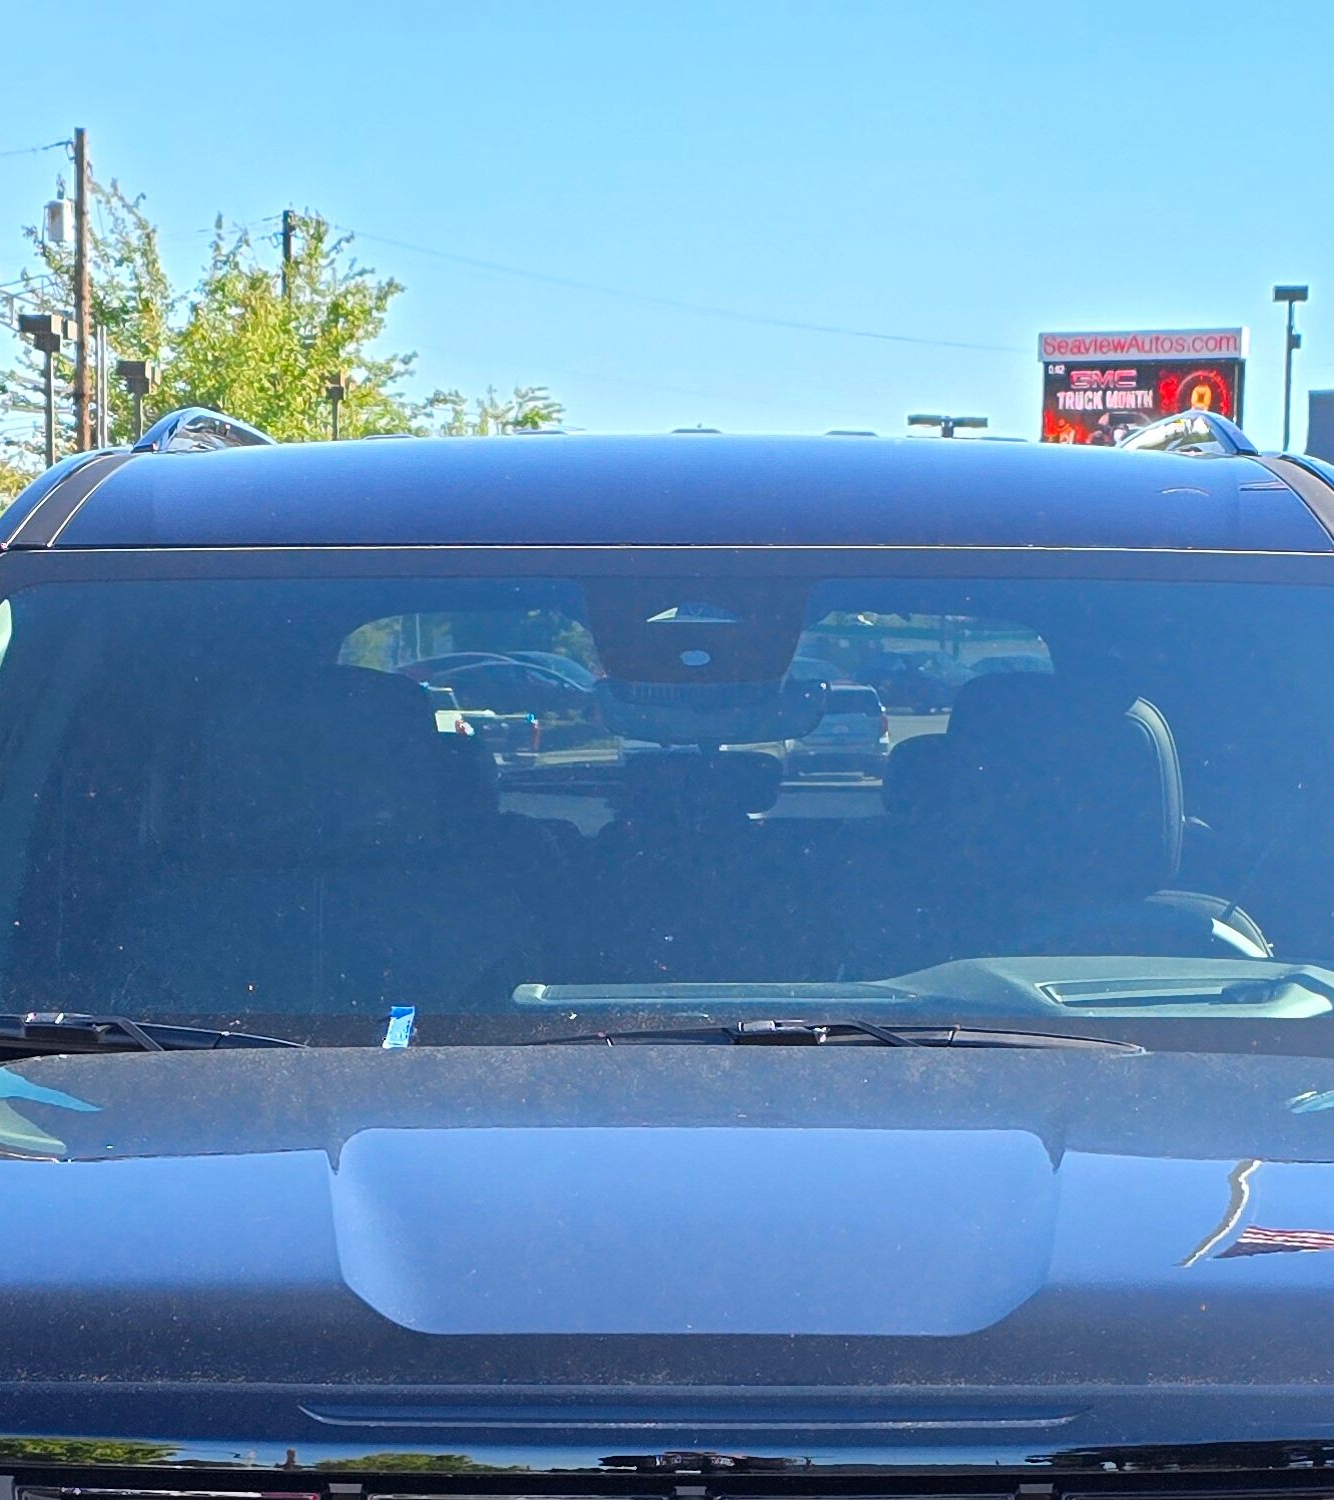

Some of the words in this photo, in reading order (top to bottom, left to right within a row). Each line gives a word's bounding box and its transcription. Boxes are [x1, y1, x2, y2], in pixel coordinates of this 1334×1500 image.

[1043, 333, 1238, 356] SeaviewAutos.com
[1070, 369, 1137, 389] GMC
[1056, 391, 1103, 410] TRUCK
[1106, 390, 1154, 409] MONTH
